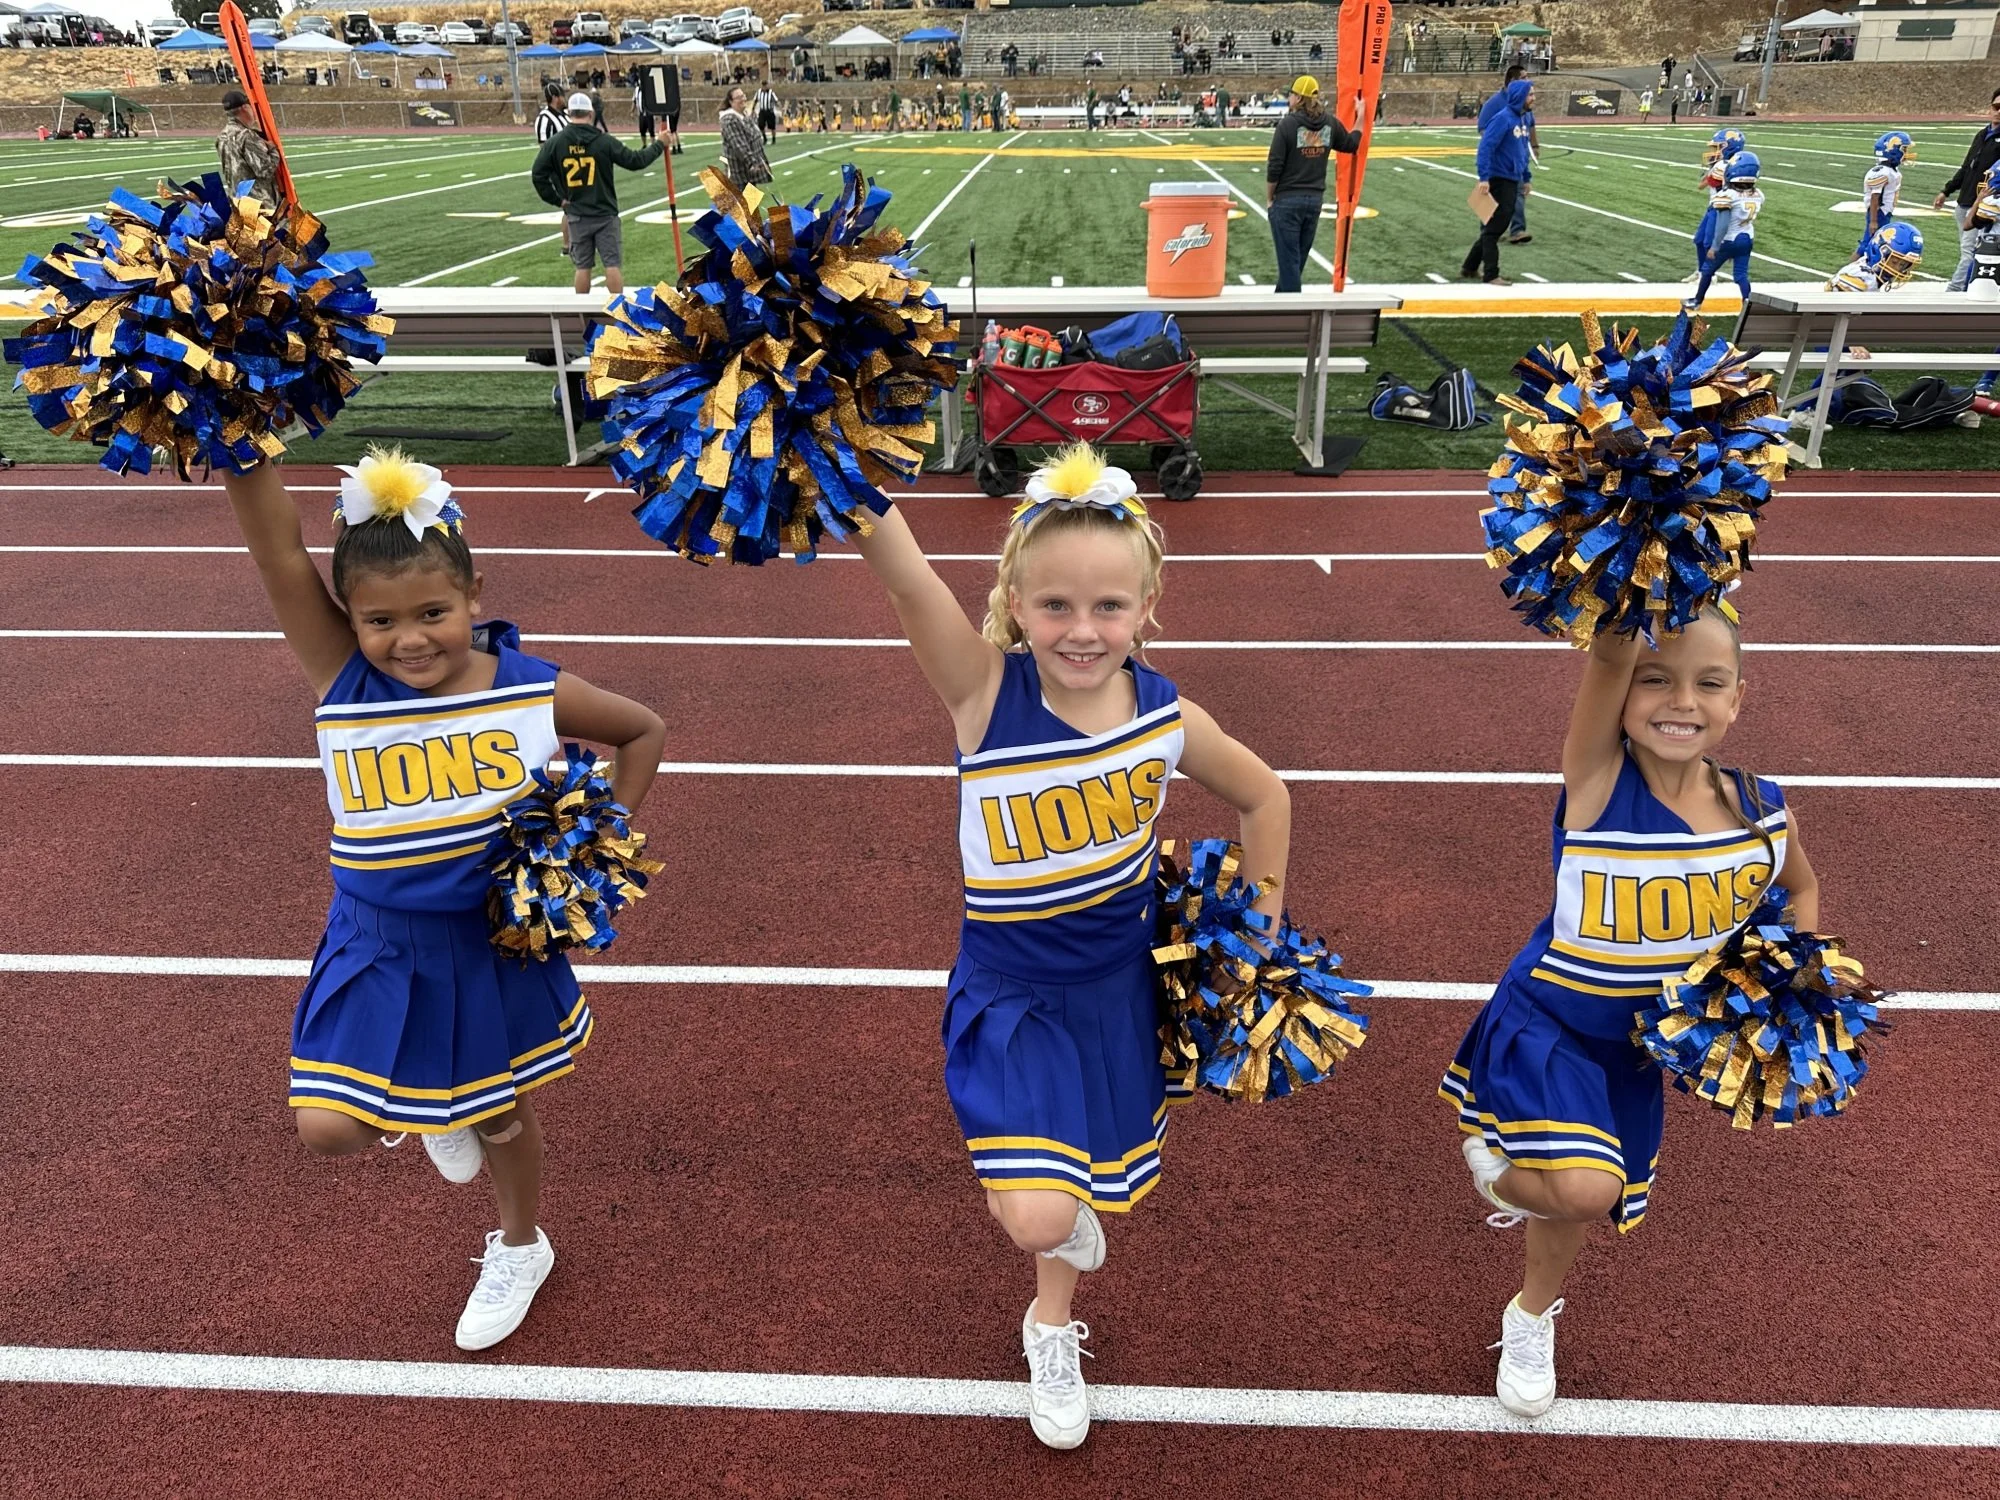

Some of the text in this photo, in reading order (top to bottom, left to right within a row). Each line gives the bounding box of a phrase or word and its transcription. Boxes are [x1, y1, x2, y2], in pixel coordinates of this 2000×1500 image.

[1370, 6, 1387, 64] PRO DOWN
[648, 67, 667, 104] 1
[563, 156, 596, 187] 27
[1163, 234, 1213, 252] Gatorade
[1006, 348, 1018, 361] G
[1072, 416, 1110, 425] 49ERS
[332, 729, 526, 813] LIONS
[980, 758, 1167, 865] LIONS
[1578, 861, 1774, 944] LIONS
